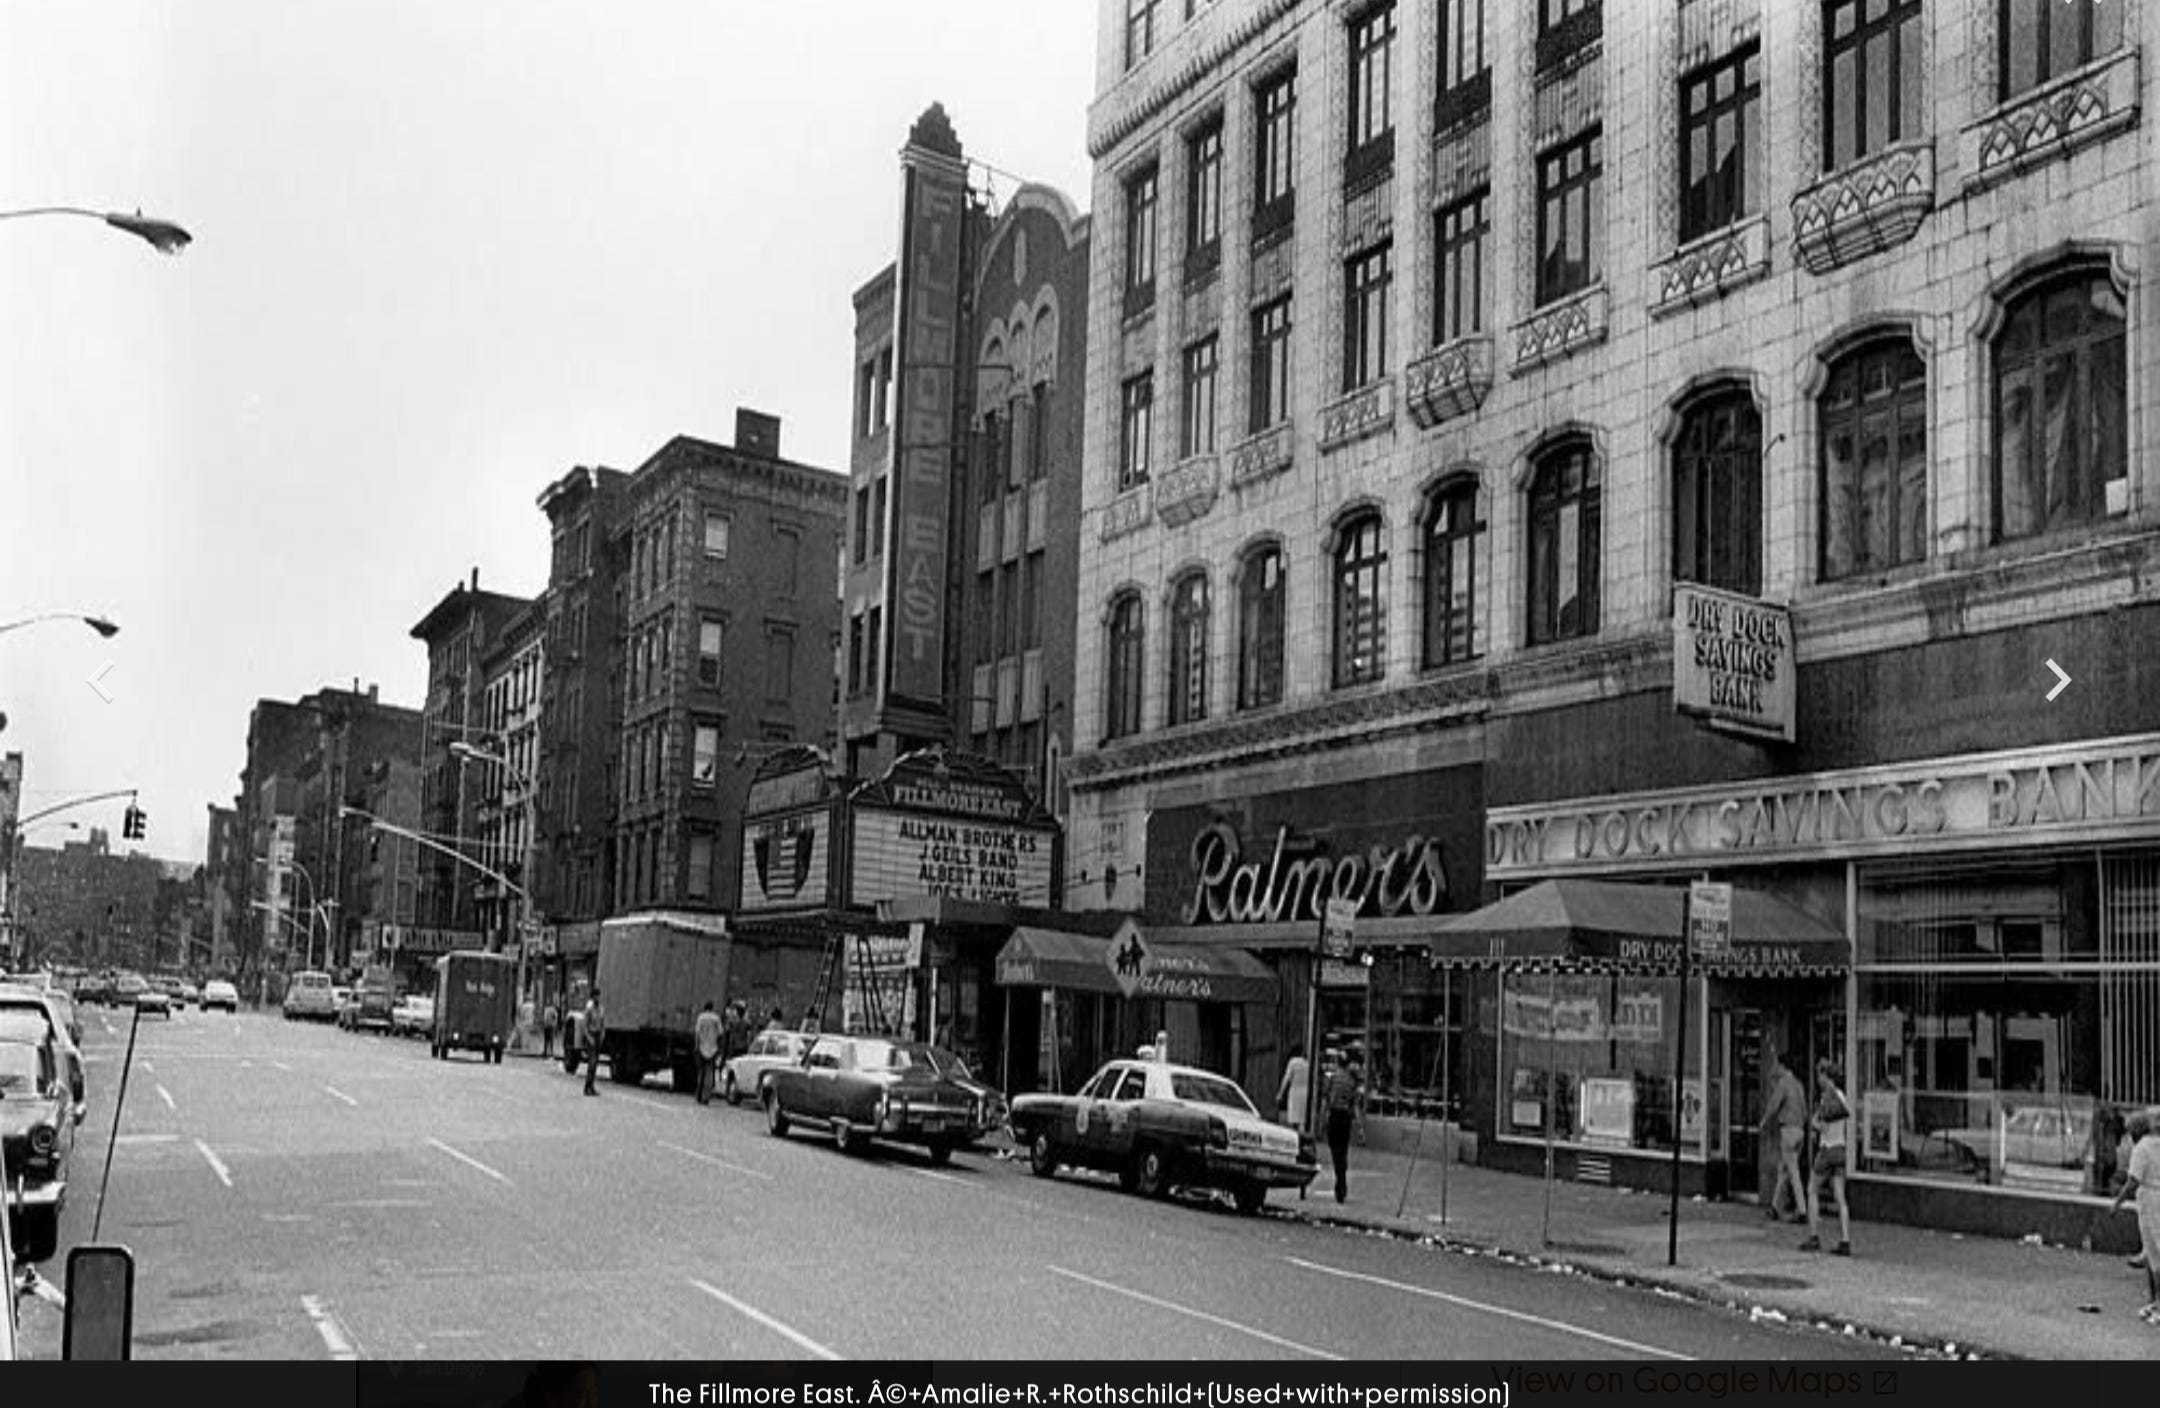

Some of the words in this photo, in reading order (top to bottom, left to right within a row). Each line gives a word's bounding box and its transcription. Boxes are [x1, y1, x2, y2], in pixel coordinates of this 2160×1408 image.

[909, 183, 951, 484] FILLMORE
[903, 513, 941, 660] EAST
[1686, 594, 1728, 634] DRY
[1732, 606, 1786, 650] DOCK
[1694, 635, 1777, 682] SAVINGS
[1709, 671, 1764, 714] BANK
[899, 820, 958, 845] ALLMAN
[963, 828, 1037, 853] BROTHERS
[1487, 816, 1551, 865] DRY
[1574, 802, 1697, 860] DOCK
[1719, 777, 1948, 849] SAVINGS
[918, 863, 974, 886] ALBERT
[980, 870, 1017, 889] KING
[978, 850, 1018, 870] BAND
[1619, 939, 1650, 959] DRY
[1654, 941, 1684, 962] DOC
[1761, 947, 1801, 964] BANK
